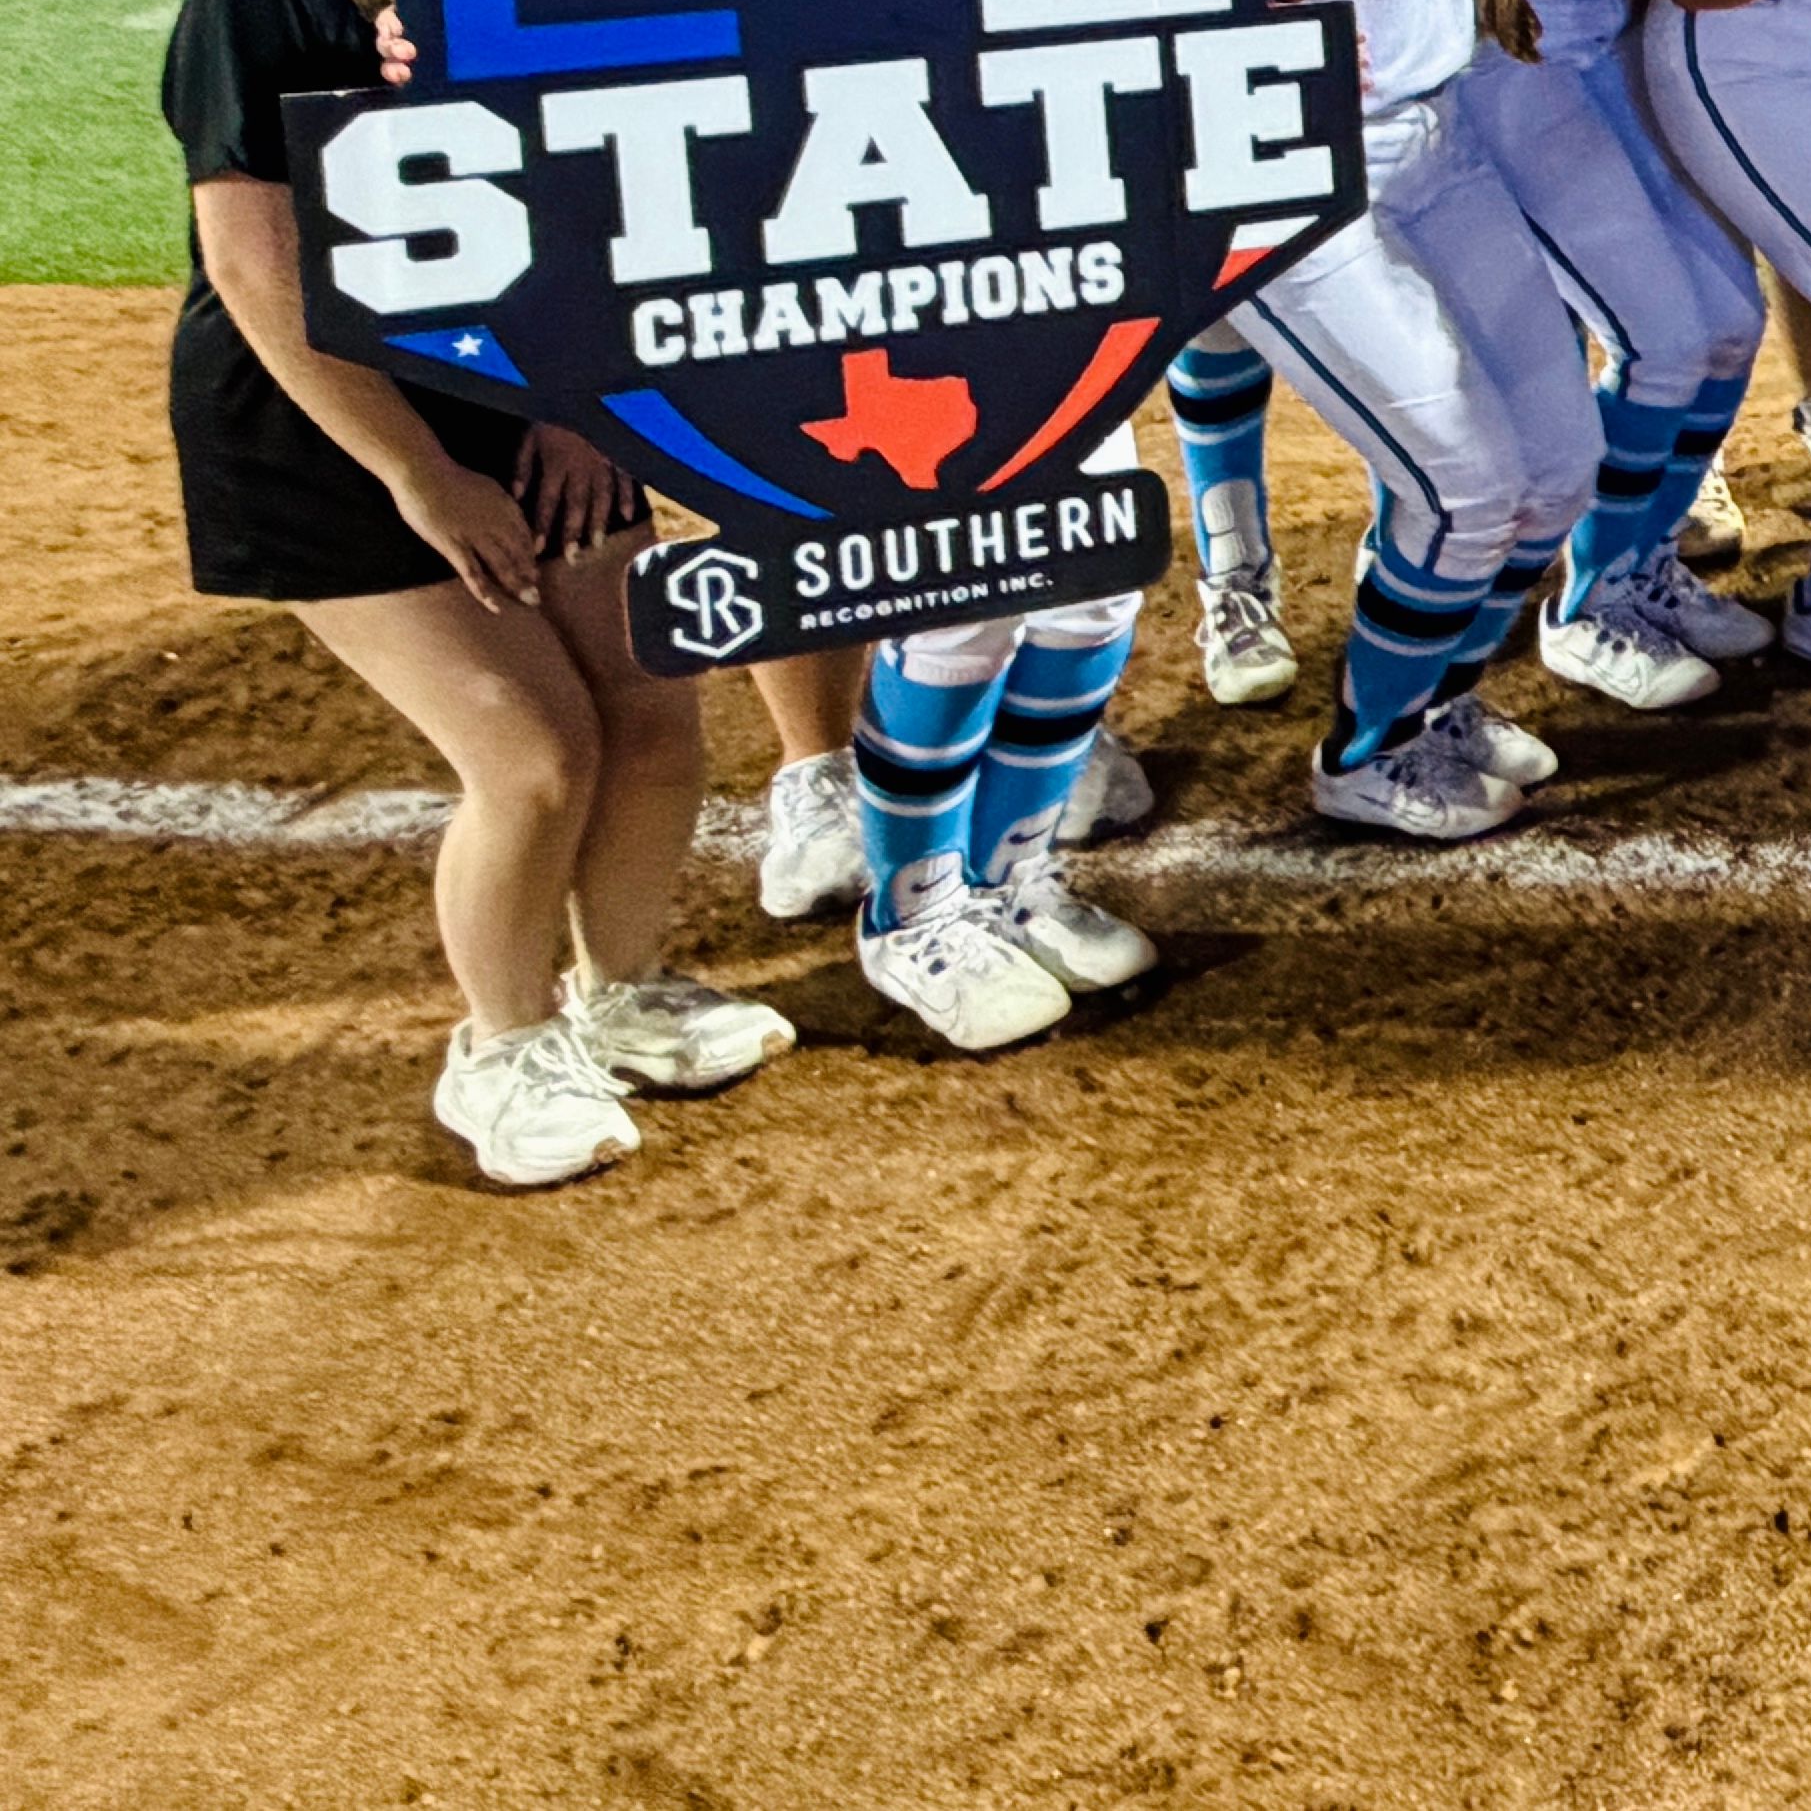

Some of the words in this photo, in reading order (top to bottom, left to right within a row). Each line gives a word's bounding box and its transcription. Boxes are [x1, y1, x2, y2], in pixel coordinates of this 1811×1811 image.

[320, 17, 1337, 316] STATE
[631, 241, 1127, 367] CHAMPIONS
[794, 487, 1139, 599] SOUTHERN
[799, 581, 990, 631] RECOGNITION
[998, 571, 1056, 594] INC.
